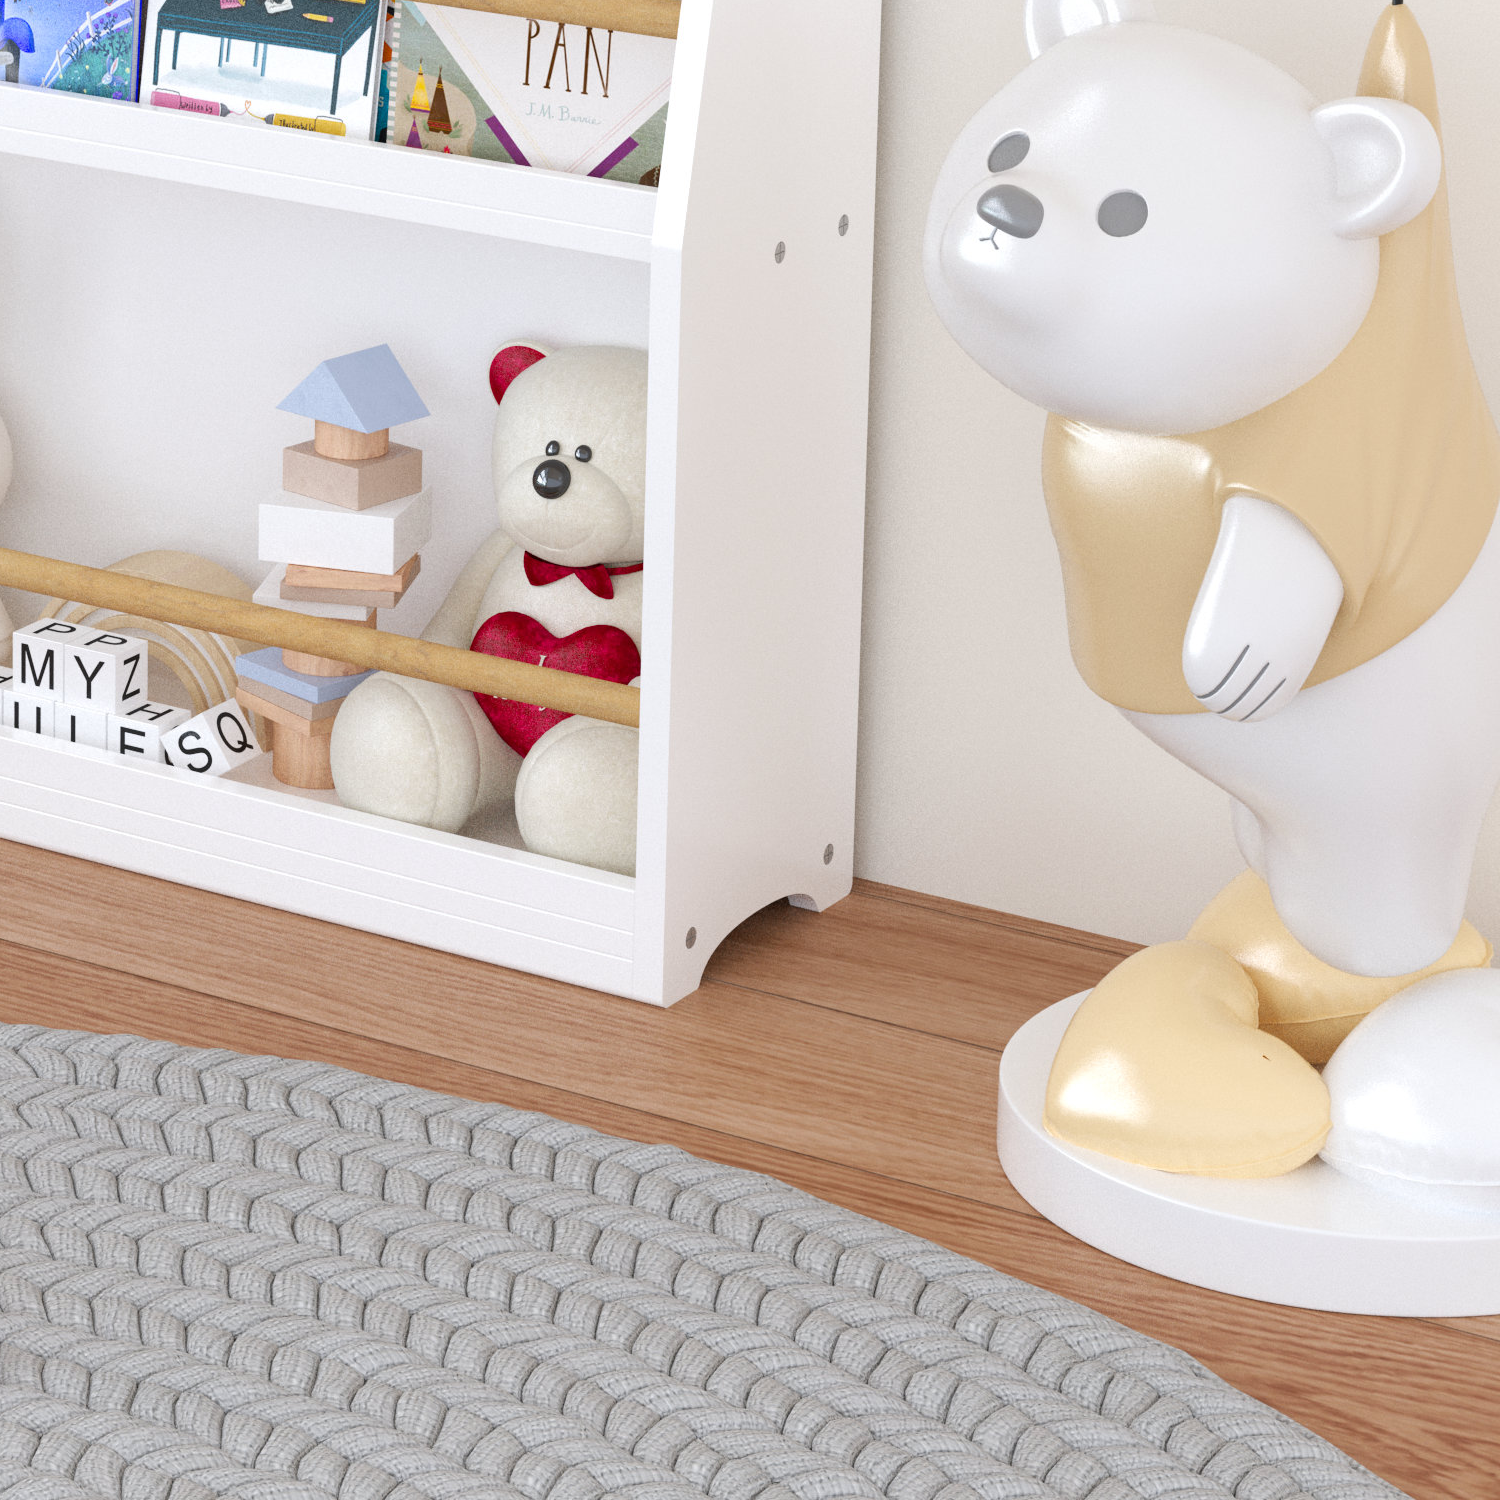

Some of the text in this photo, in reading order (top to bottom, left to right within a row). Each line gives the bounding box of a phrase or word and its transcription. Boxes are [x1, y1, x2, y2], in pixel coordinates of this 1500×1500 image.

[522, 18, 613, 98] PAN
[559, 105, 602, 125] Barrie
[32, 621, 77, 637] P
[83, 633, 128, 648] P
